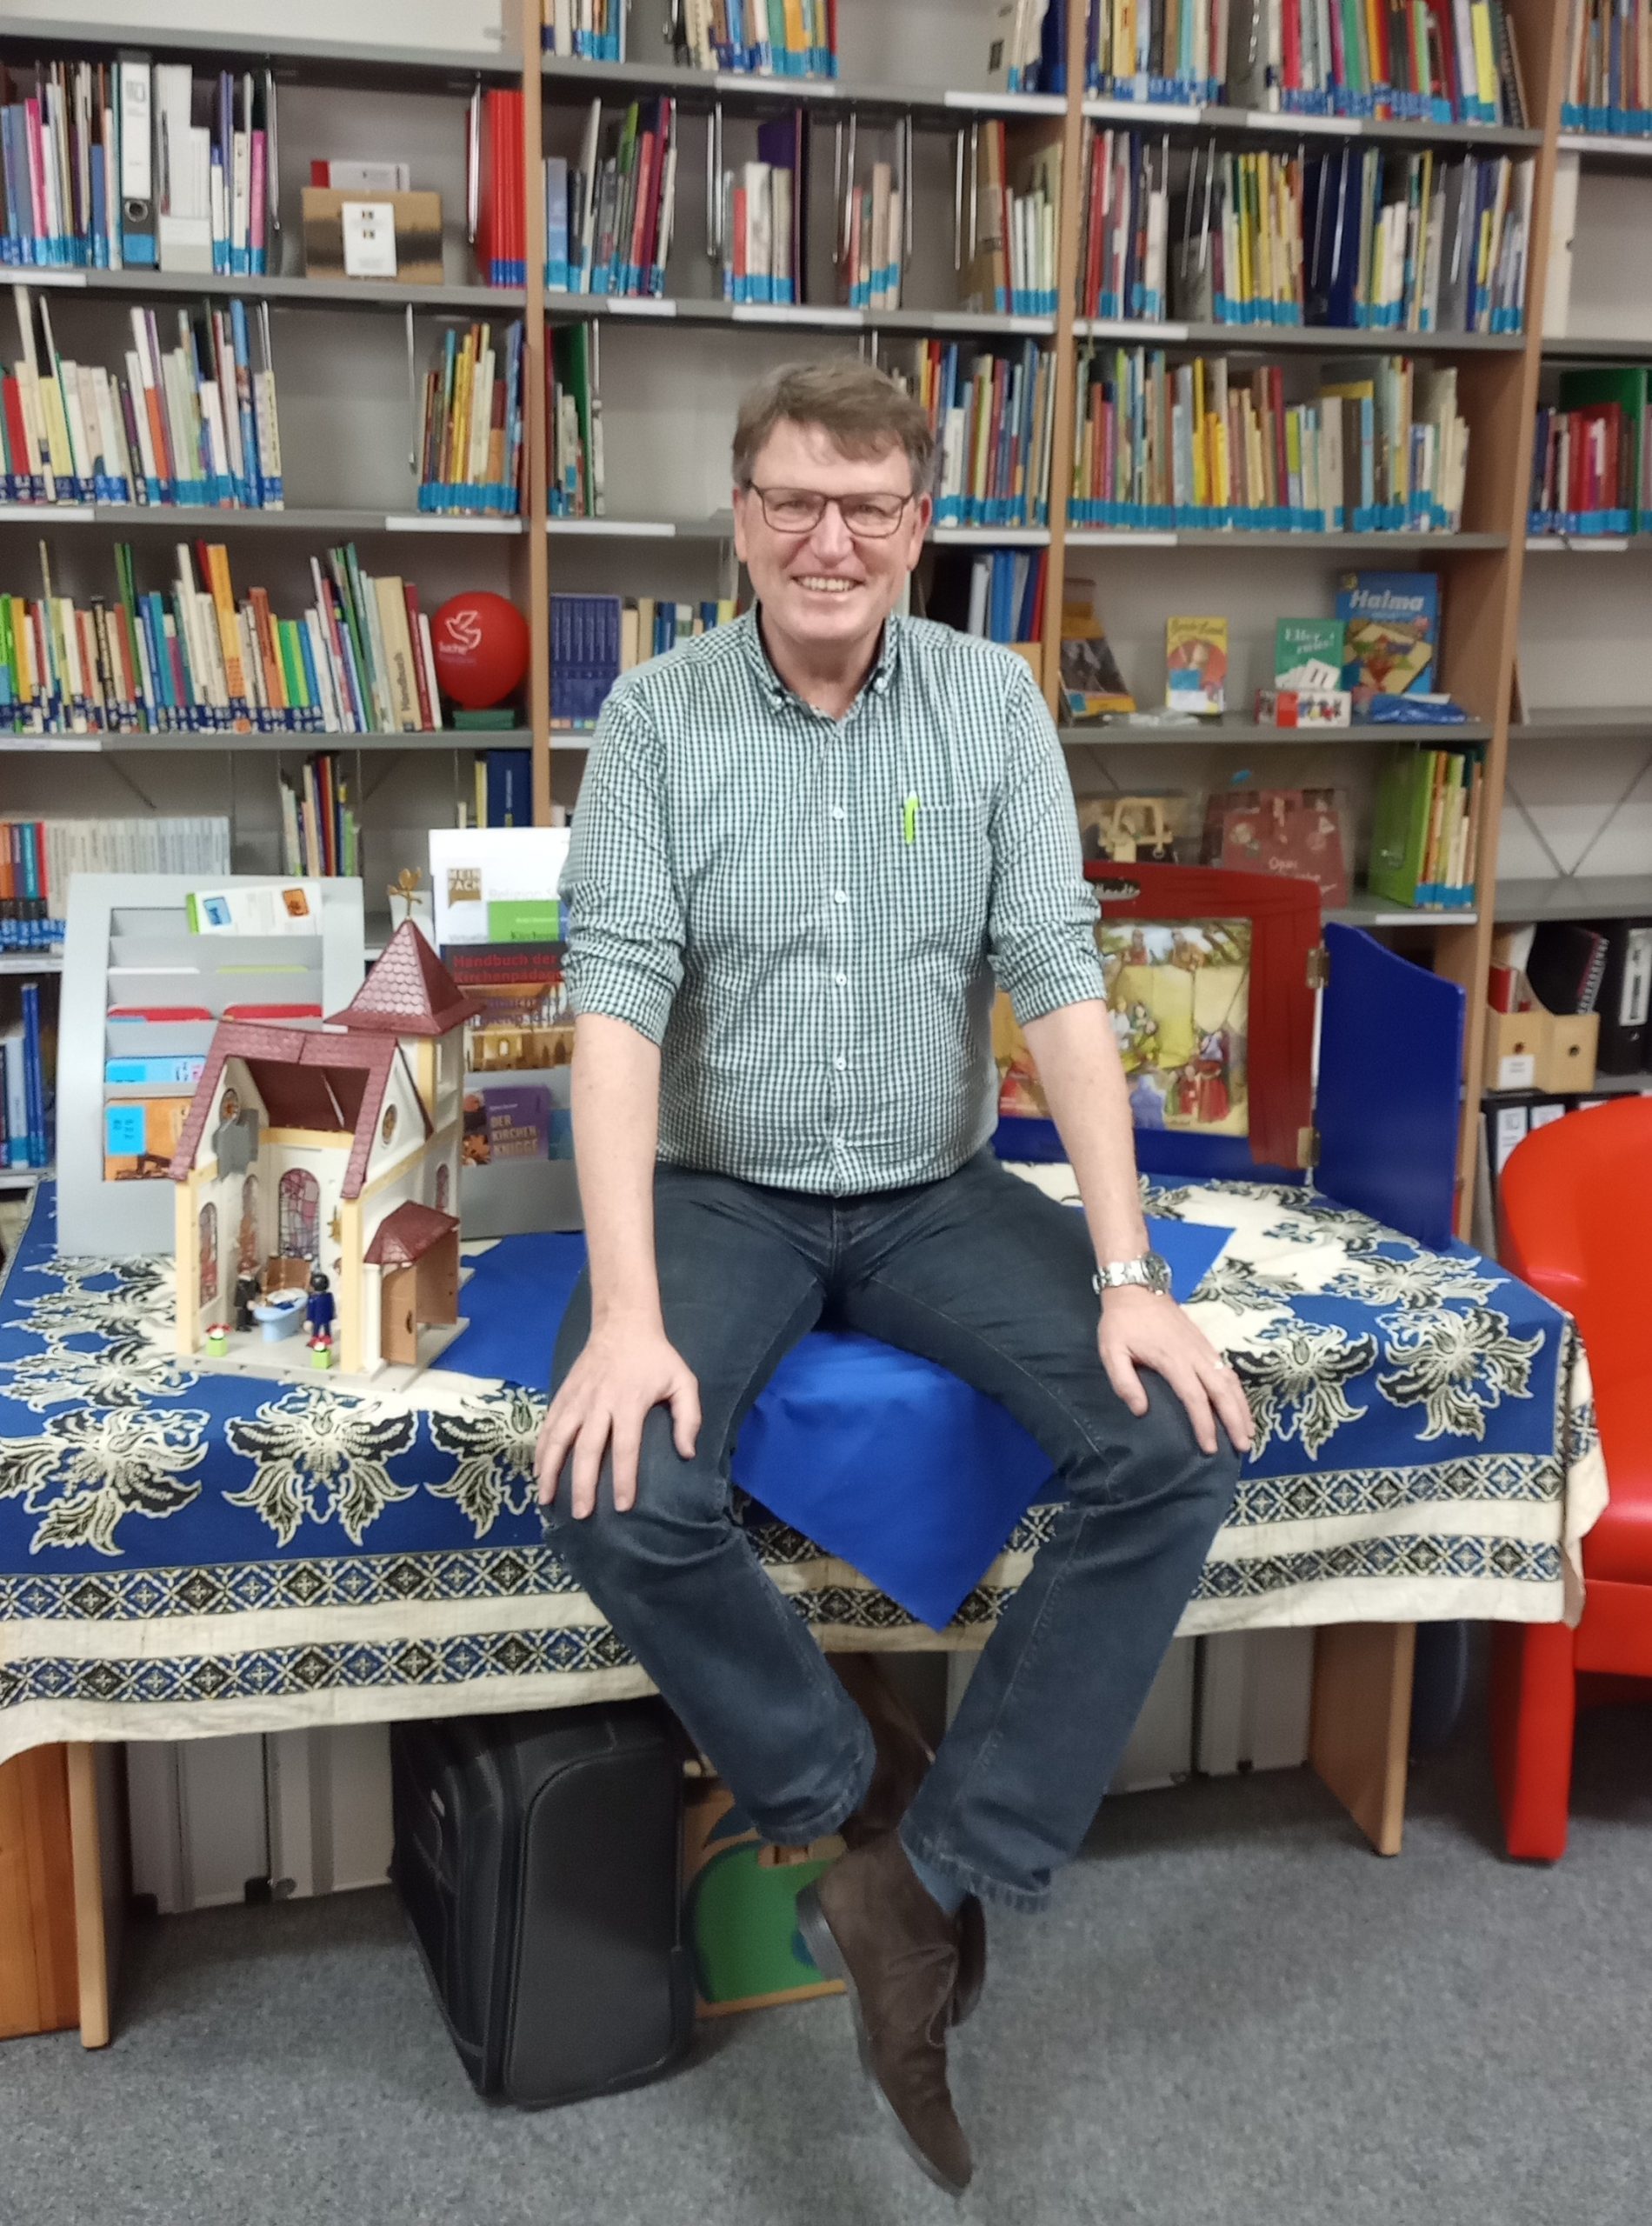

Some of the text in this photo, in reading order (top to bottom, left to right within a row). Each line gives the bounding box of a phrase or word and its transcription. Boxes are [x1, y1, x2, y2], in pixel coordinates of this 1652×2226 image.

[1349, 590, 1424, 611] Halma
[393, 651, 411, 711] Handbuch
[454, 952, 557, 967] Handbuch der
[490, 1115, 511, 1128] DER
